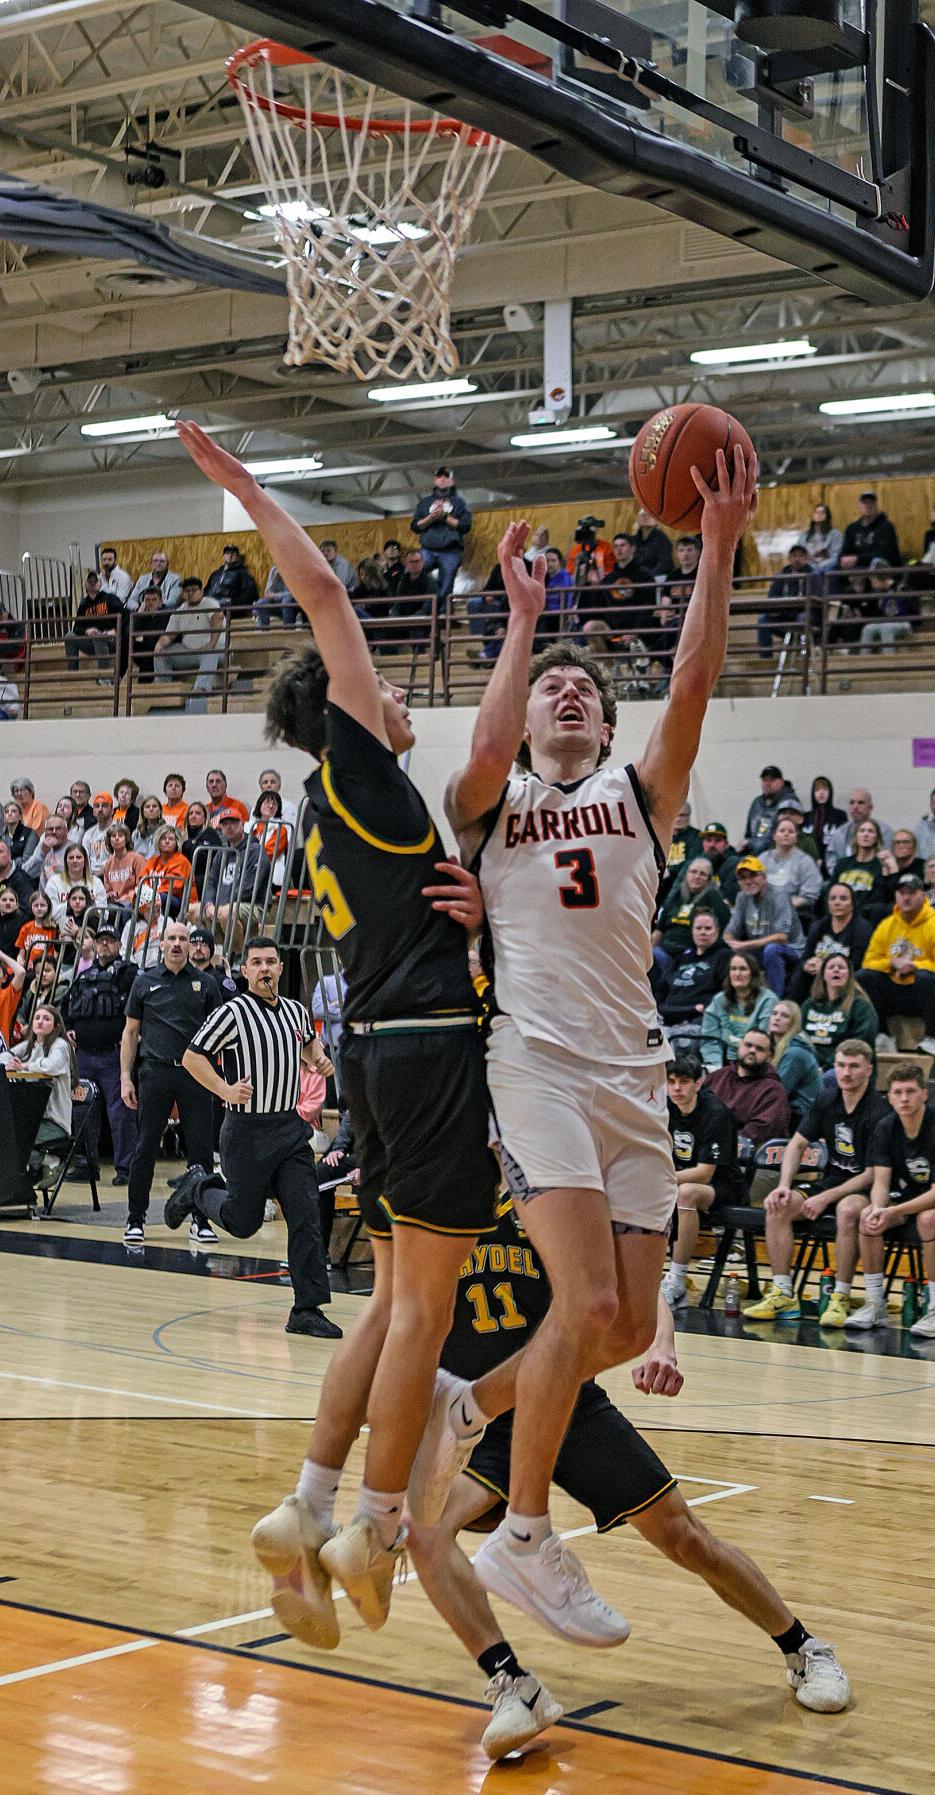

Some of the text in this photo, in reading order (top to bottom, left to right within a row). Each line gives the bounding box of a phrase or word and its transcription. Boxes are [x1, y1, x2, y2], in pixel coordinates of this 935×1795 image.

[505, 801, 637, 849] CARROLL
[305, 823, 357, 940] 5
[554, 847, 600, 909] 3
[673, 1129, 695, 1161] S
[766, 1146, 820, 1166] TIRS
[458, 1243, 540, 1280] AYDEL
[465, 1281, 527, 1334] 11
